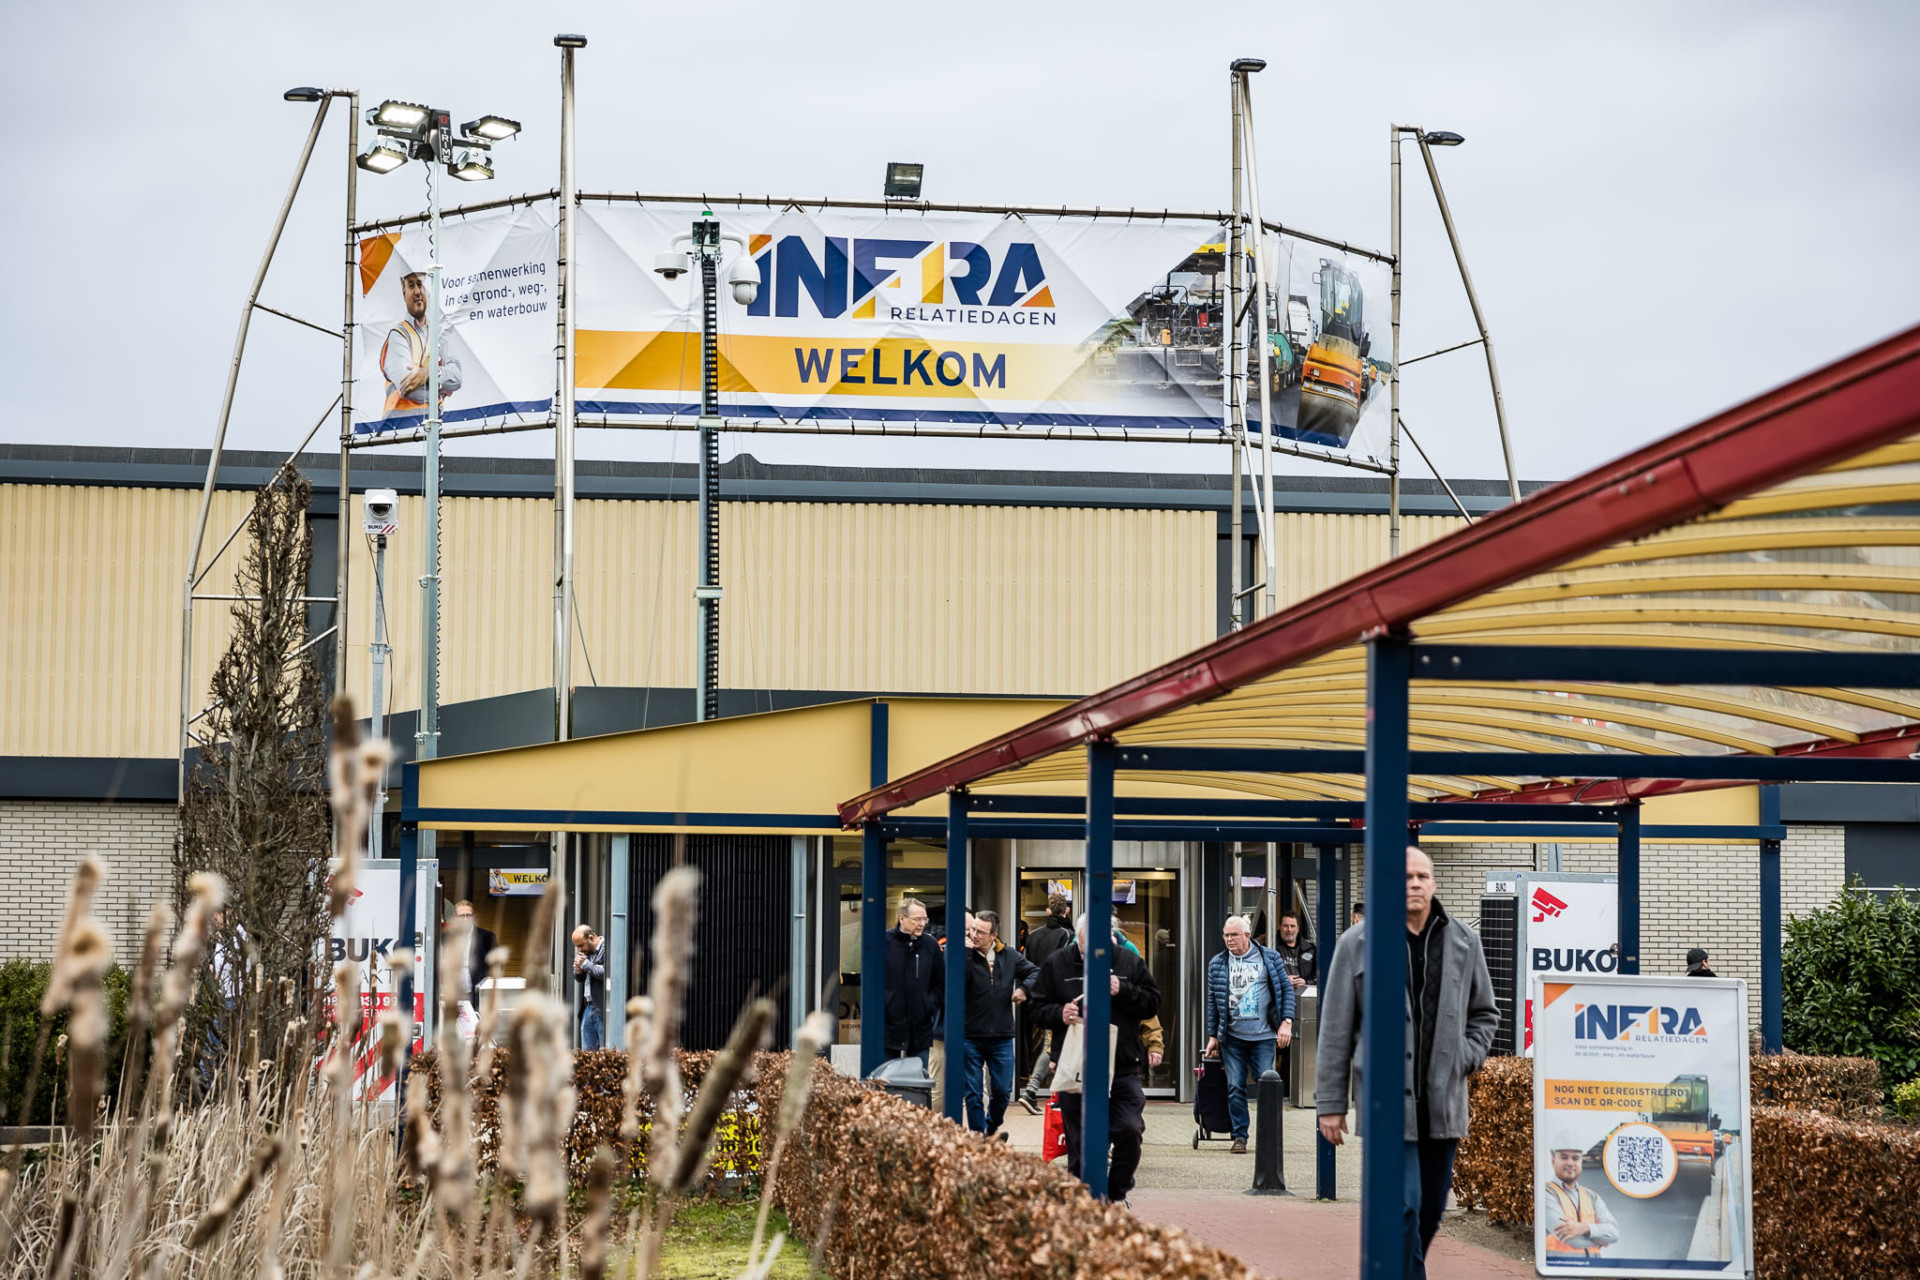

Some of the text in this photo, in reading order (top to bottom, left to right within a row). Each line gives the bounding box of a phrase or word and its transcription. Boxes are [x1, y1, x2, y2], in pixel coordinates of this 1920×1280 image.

[440, 127, 452, 163] TRIME
[441, 278, 465, 289] Voor
[747, 234, 1055, 319] INFRA
[445, 295, 455, 306] in
[469, 302, 548, 321] en waterbouw
[891, 307, 1056, 325] RELATIEDAGEN
[795, 348, 1006, 388] WELKOM
[514, 874, 548, 883] WELKO
[1533, 948, 1617, 973] BUKO
[1575, 1004, 1707, 1041] INFRA
[1635, 1034, 1708, 1044] RELATIEDAGEN
[1554, 1085, 1690, 1097] NOG NIET GEREGISTREERD?
[1554, 1097, 1643, 1107] SCAN DE QR-CODE
